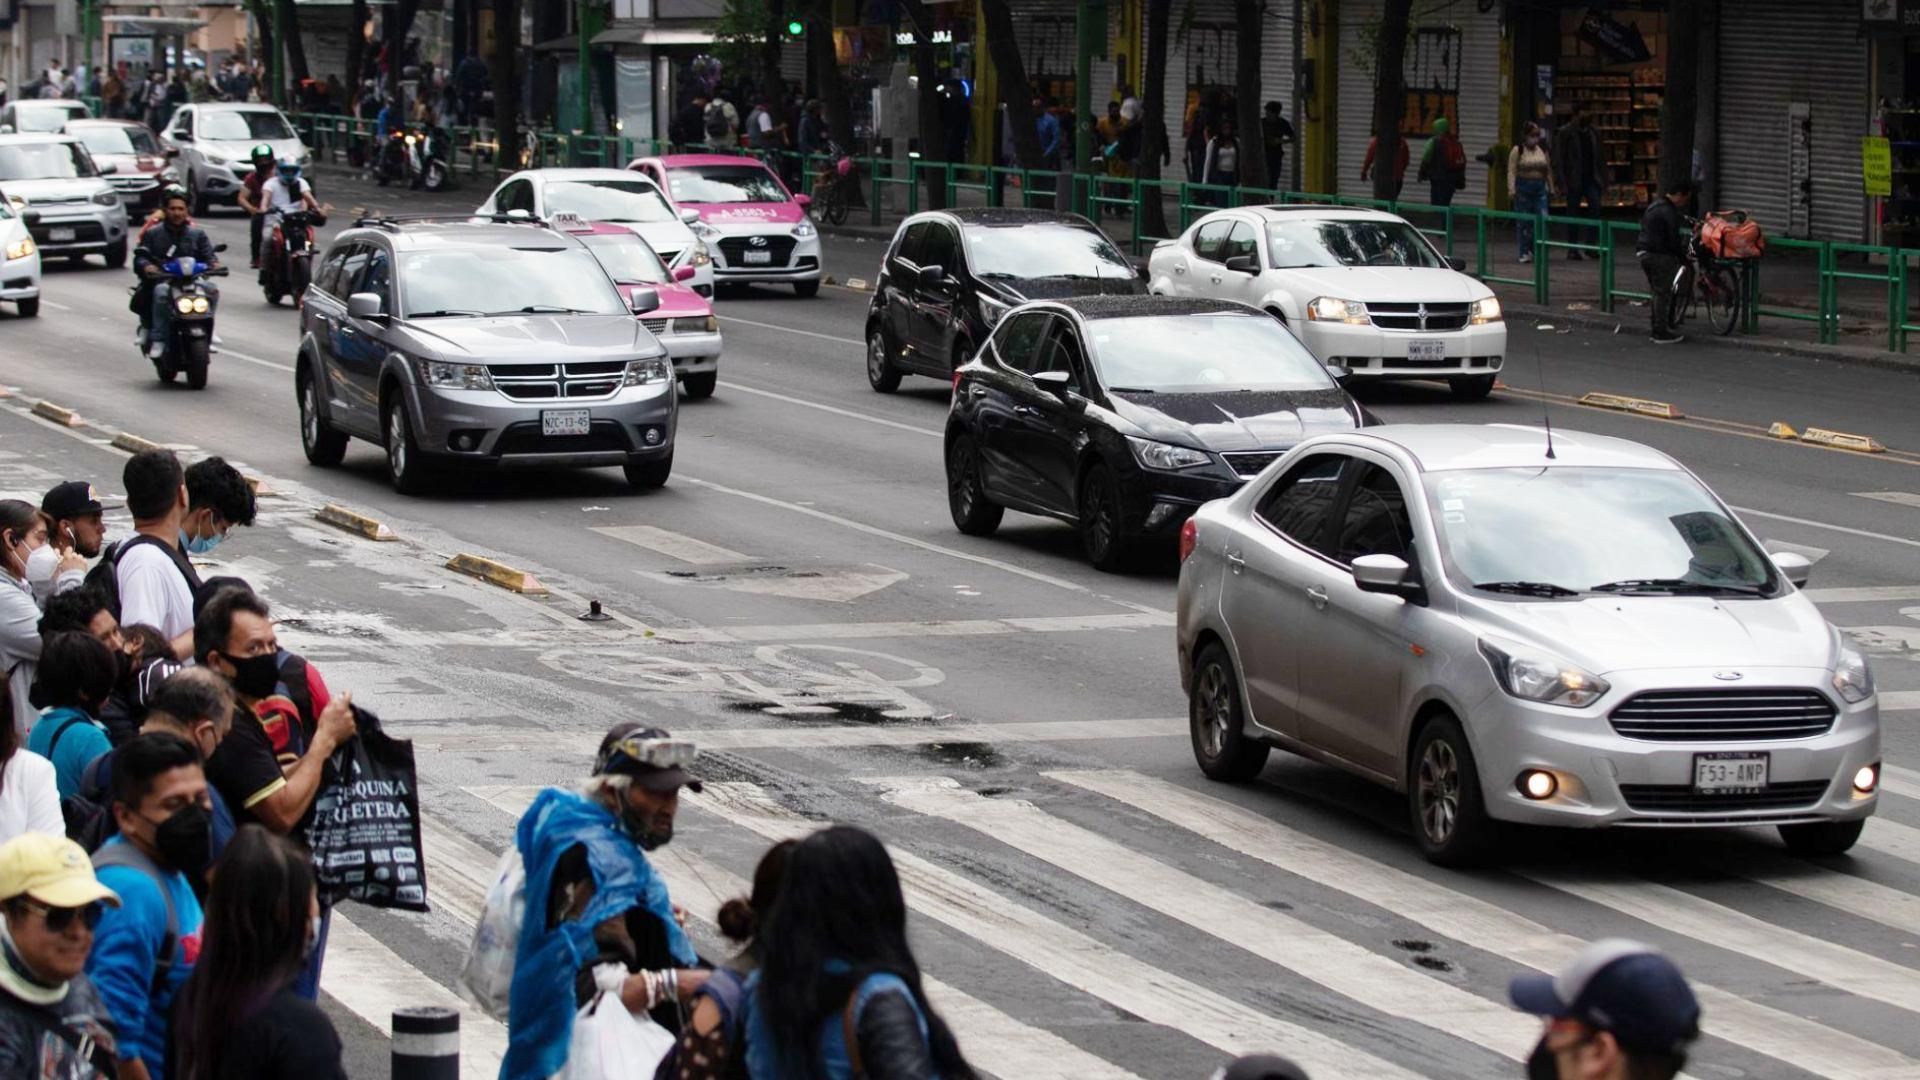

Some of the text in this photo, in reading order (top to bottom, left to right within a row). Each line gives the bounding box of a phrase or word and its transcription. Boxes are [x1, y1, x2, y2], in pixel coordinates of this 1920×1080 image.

[557, 213, 577, 224] TAXI
[544, 416, 588, 429] NZC-13-45
[1698, 763, 1764, 783] F53-ANP
